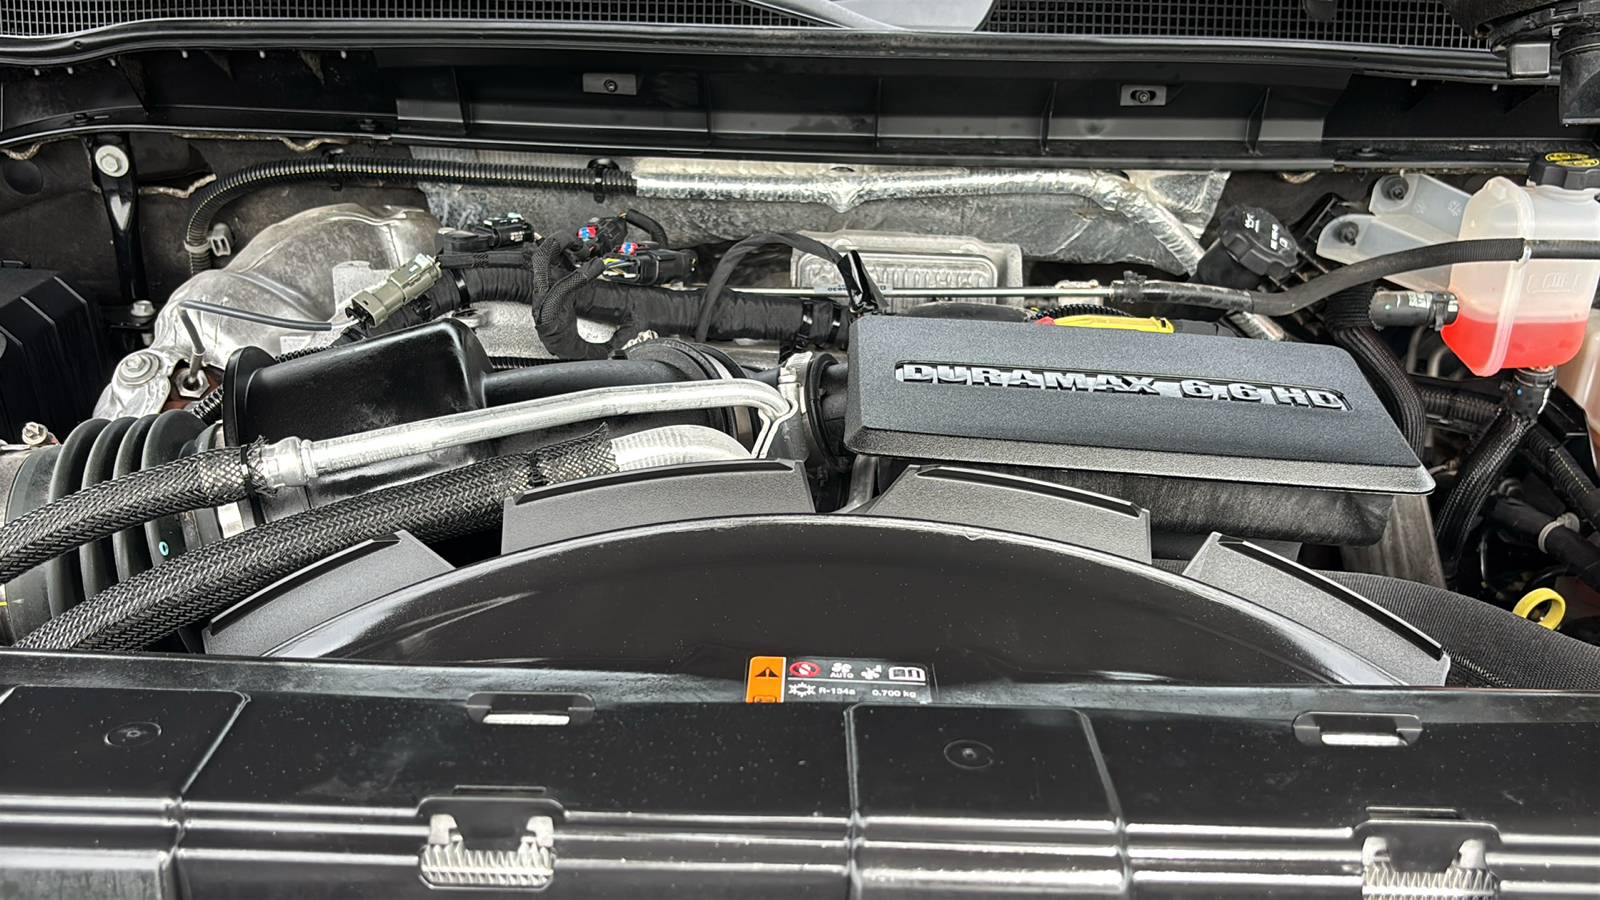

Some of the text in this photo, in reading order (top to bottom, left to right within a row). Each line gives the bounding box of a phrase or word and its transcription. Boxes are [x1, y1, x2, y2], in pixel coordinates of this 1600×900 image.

[902, 363, 1344, 409] DURAMAX 6.6 HD
[829, 671, 854, 679] AUTO
[818, 686, 917, 699] R-134a 0.700 kg
